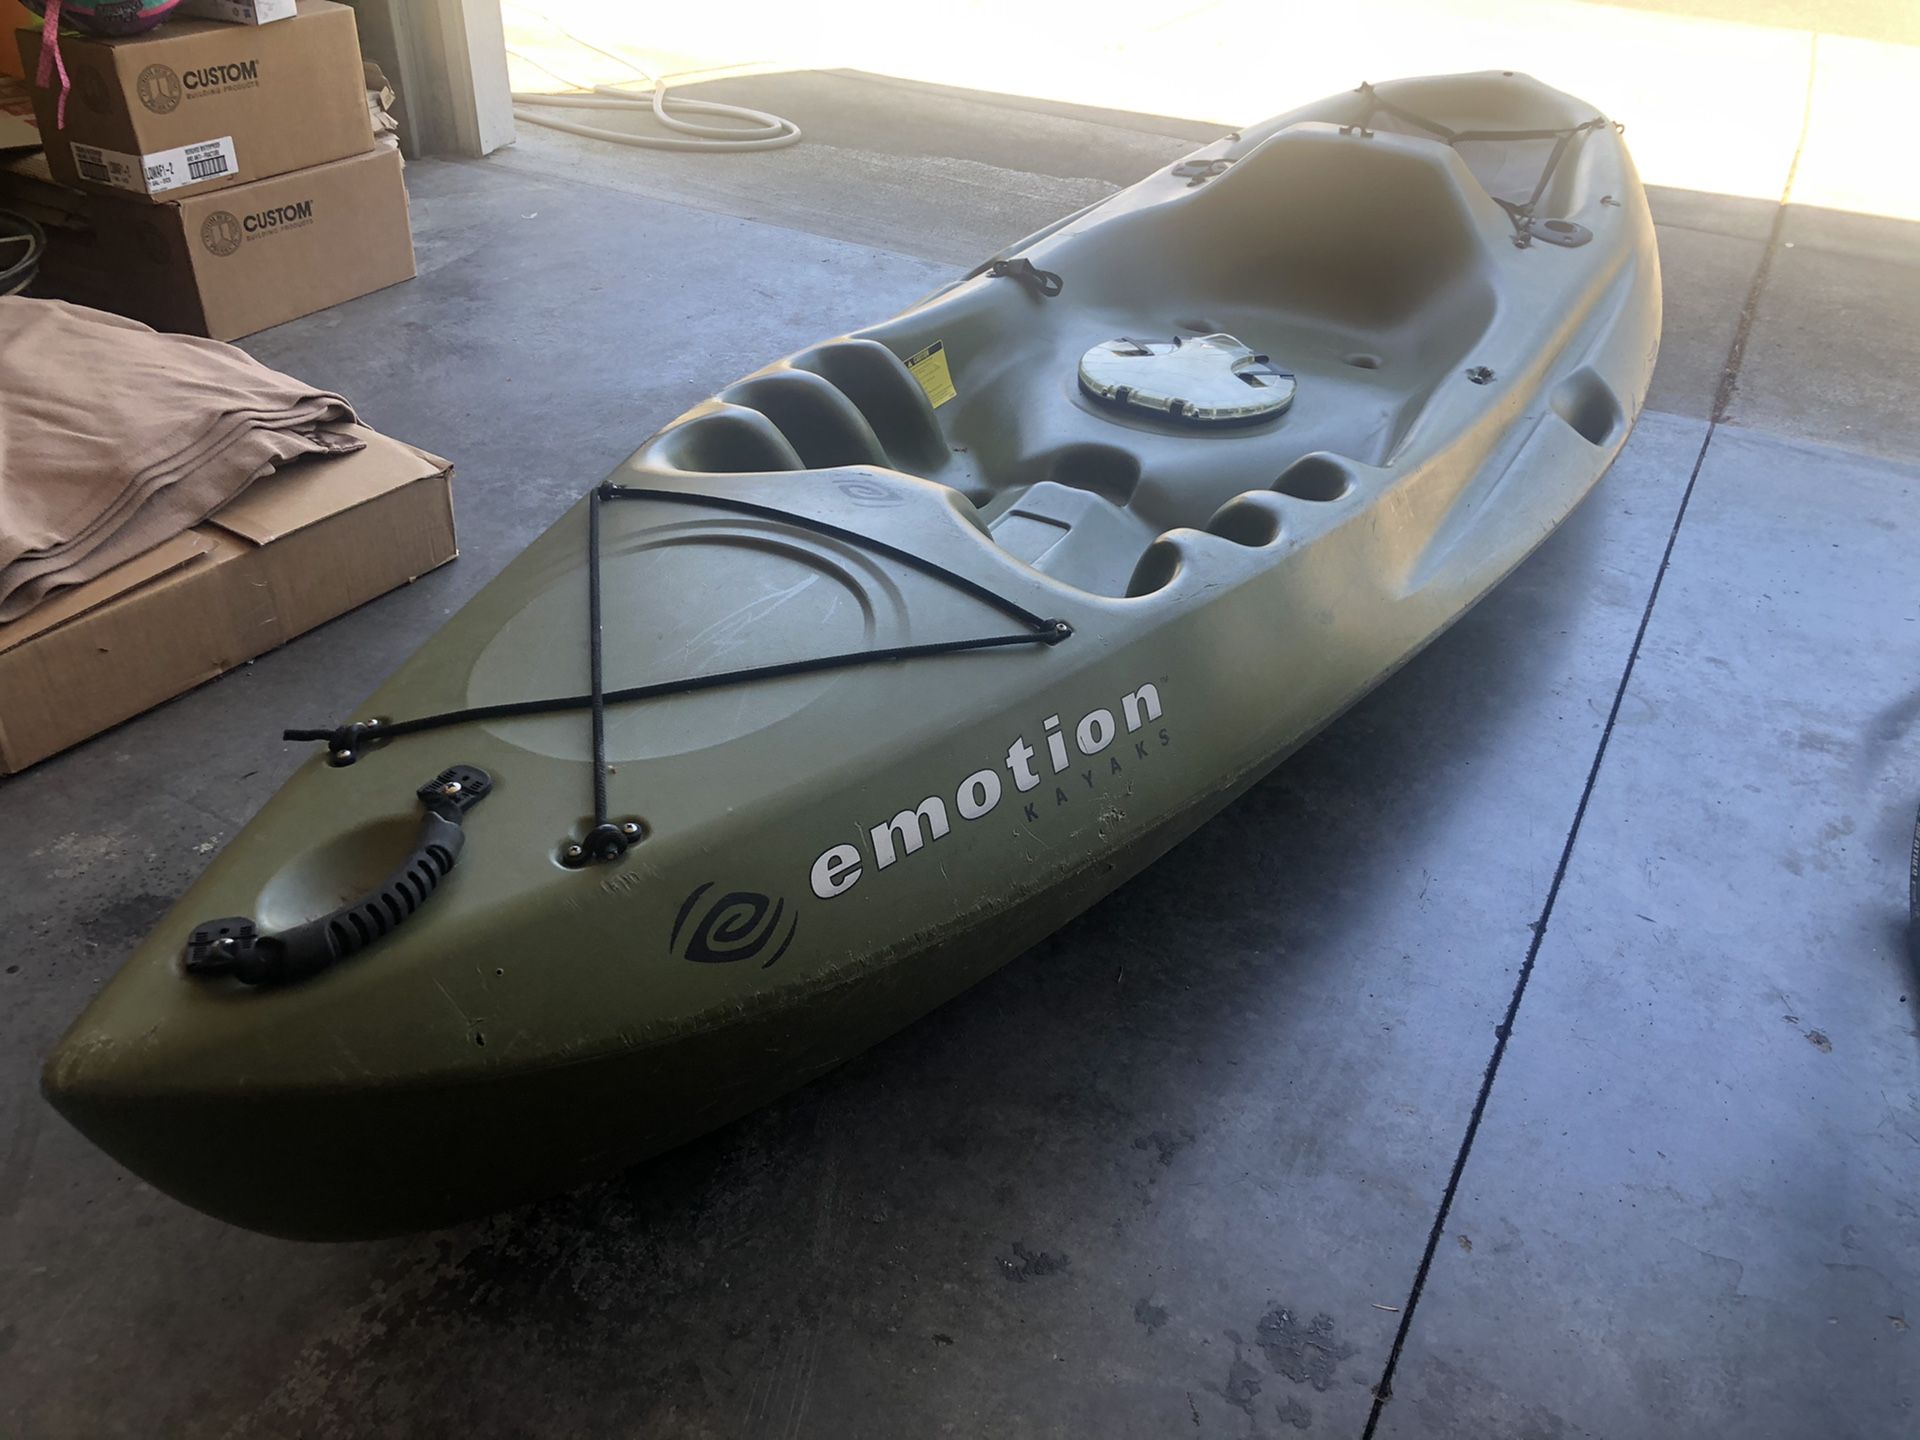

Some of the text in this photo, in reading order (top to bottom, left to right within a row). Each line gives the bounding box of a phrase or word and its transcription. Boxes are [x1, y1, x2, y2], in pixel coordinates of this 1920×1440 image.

[182, 60, 258, 90] CUSTOM
[243, 200, 312, 232] CUSTOM
[810, 682, 1163, 900] emotion
[1023, 728, 1170, 823] KAYAKS
